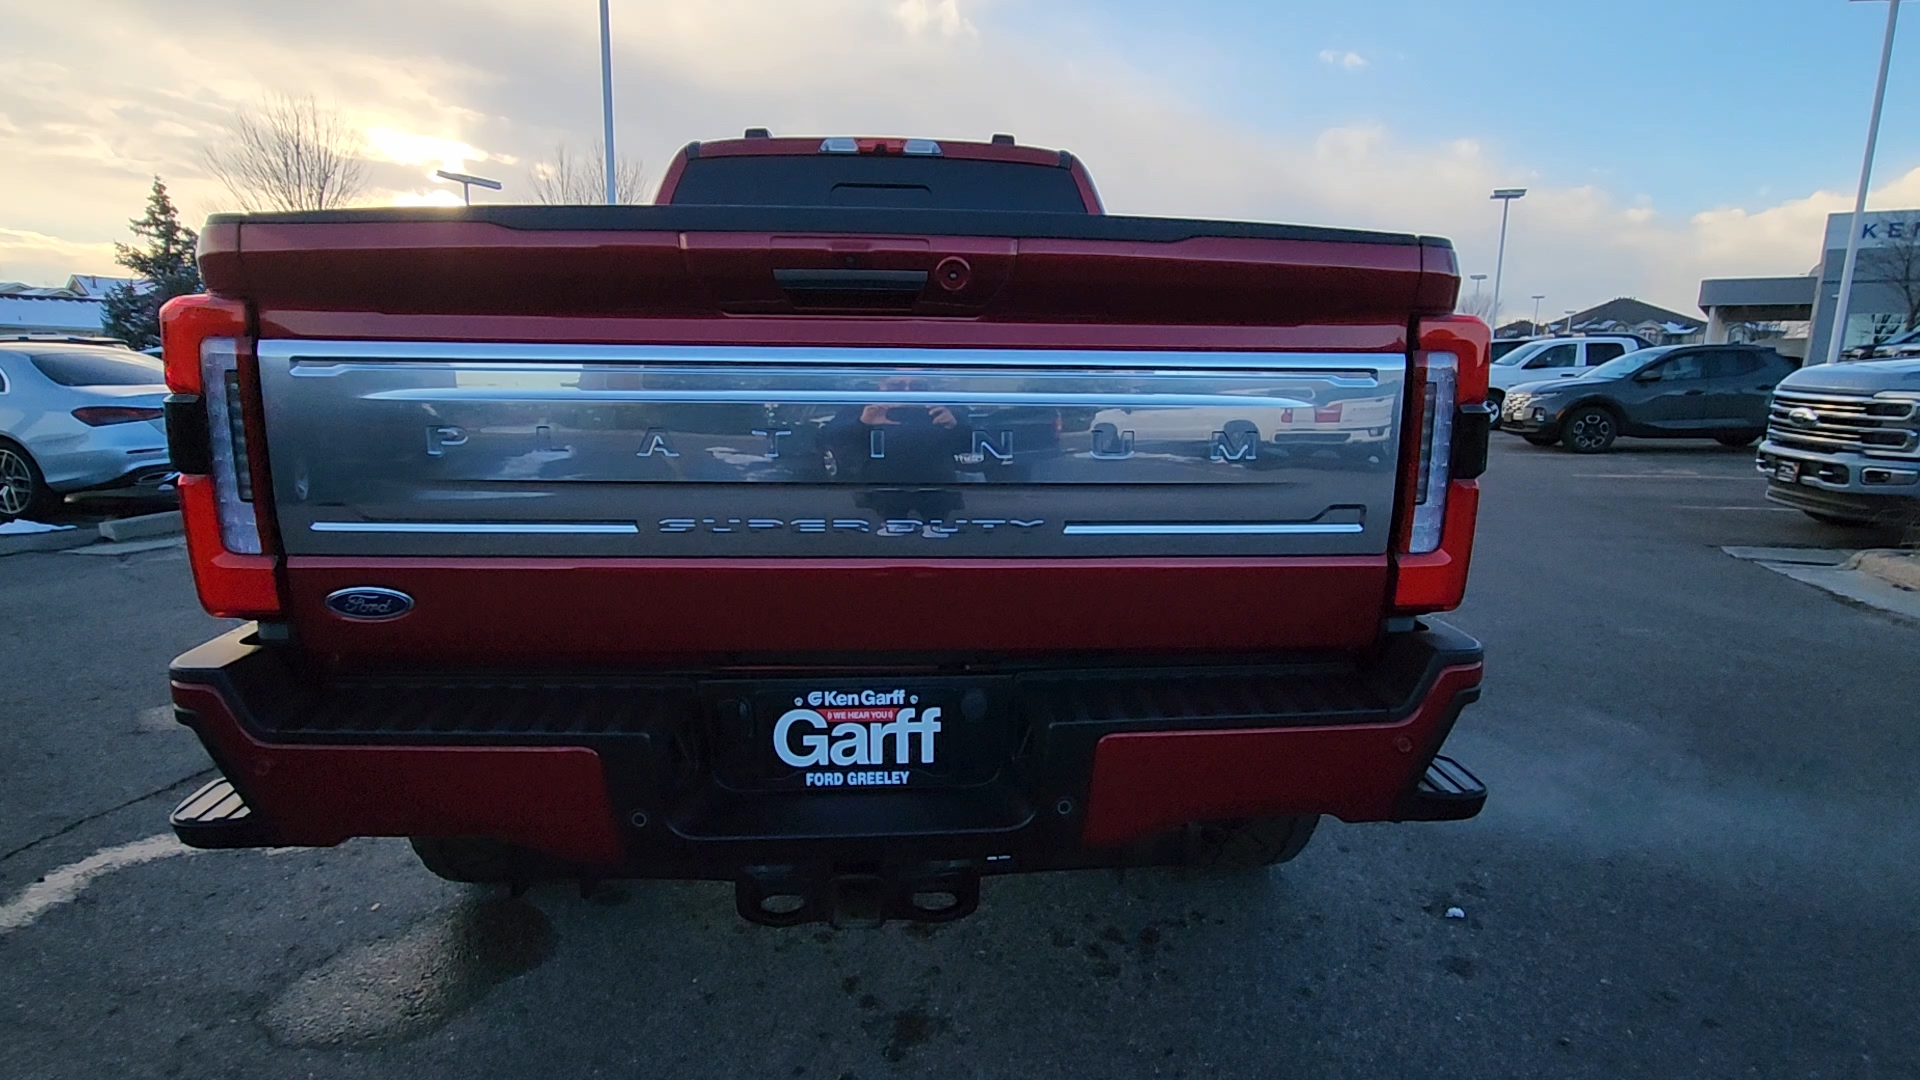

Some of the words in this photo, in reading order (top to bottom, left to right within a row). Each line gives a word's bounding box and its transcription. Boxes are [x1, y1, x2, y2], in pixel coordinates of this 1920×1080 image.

[426, 425, 1258, 460] PLATINUM
[345, 594, 392, 613] Ford
[824, 690, 859, 706] Ken
[860, 689, 906, 706] Garff
[833, 711, 847, 719] WE
[847, 711, 870, 719] HEAR
[870, 710, 888, 719] YOU
[773, 707, 942, 768] Garff
[806, 772, 843, 786] FORD
[847, 771, 910, 785] GREELEY
